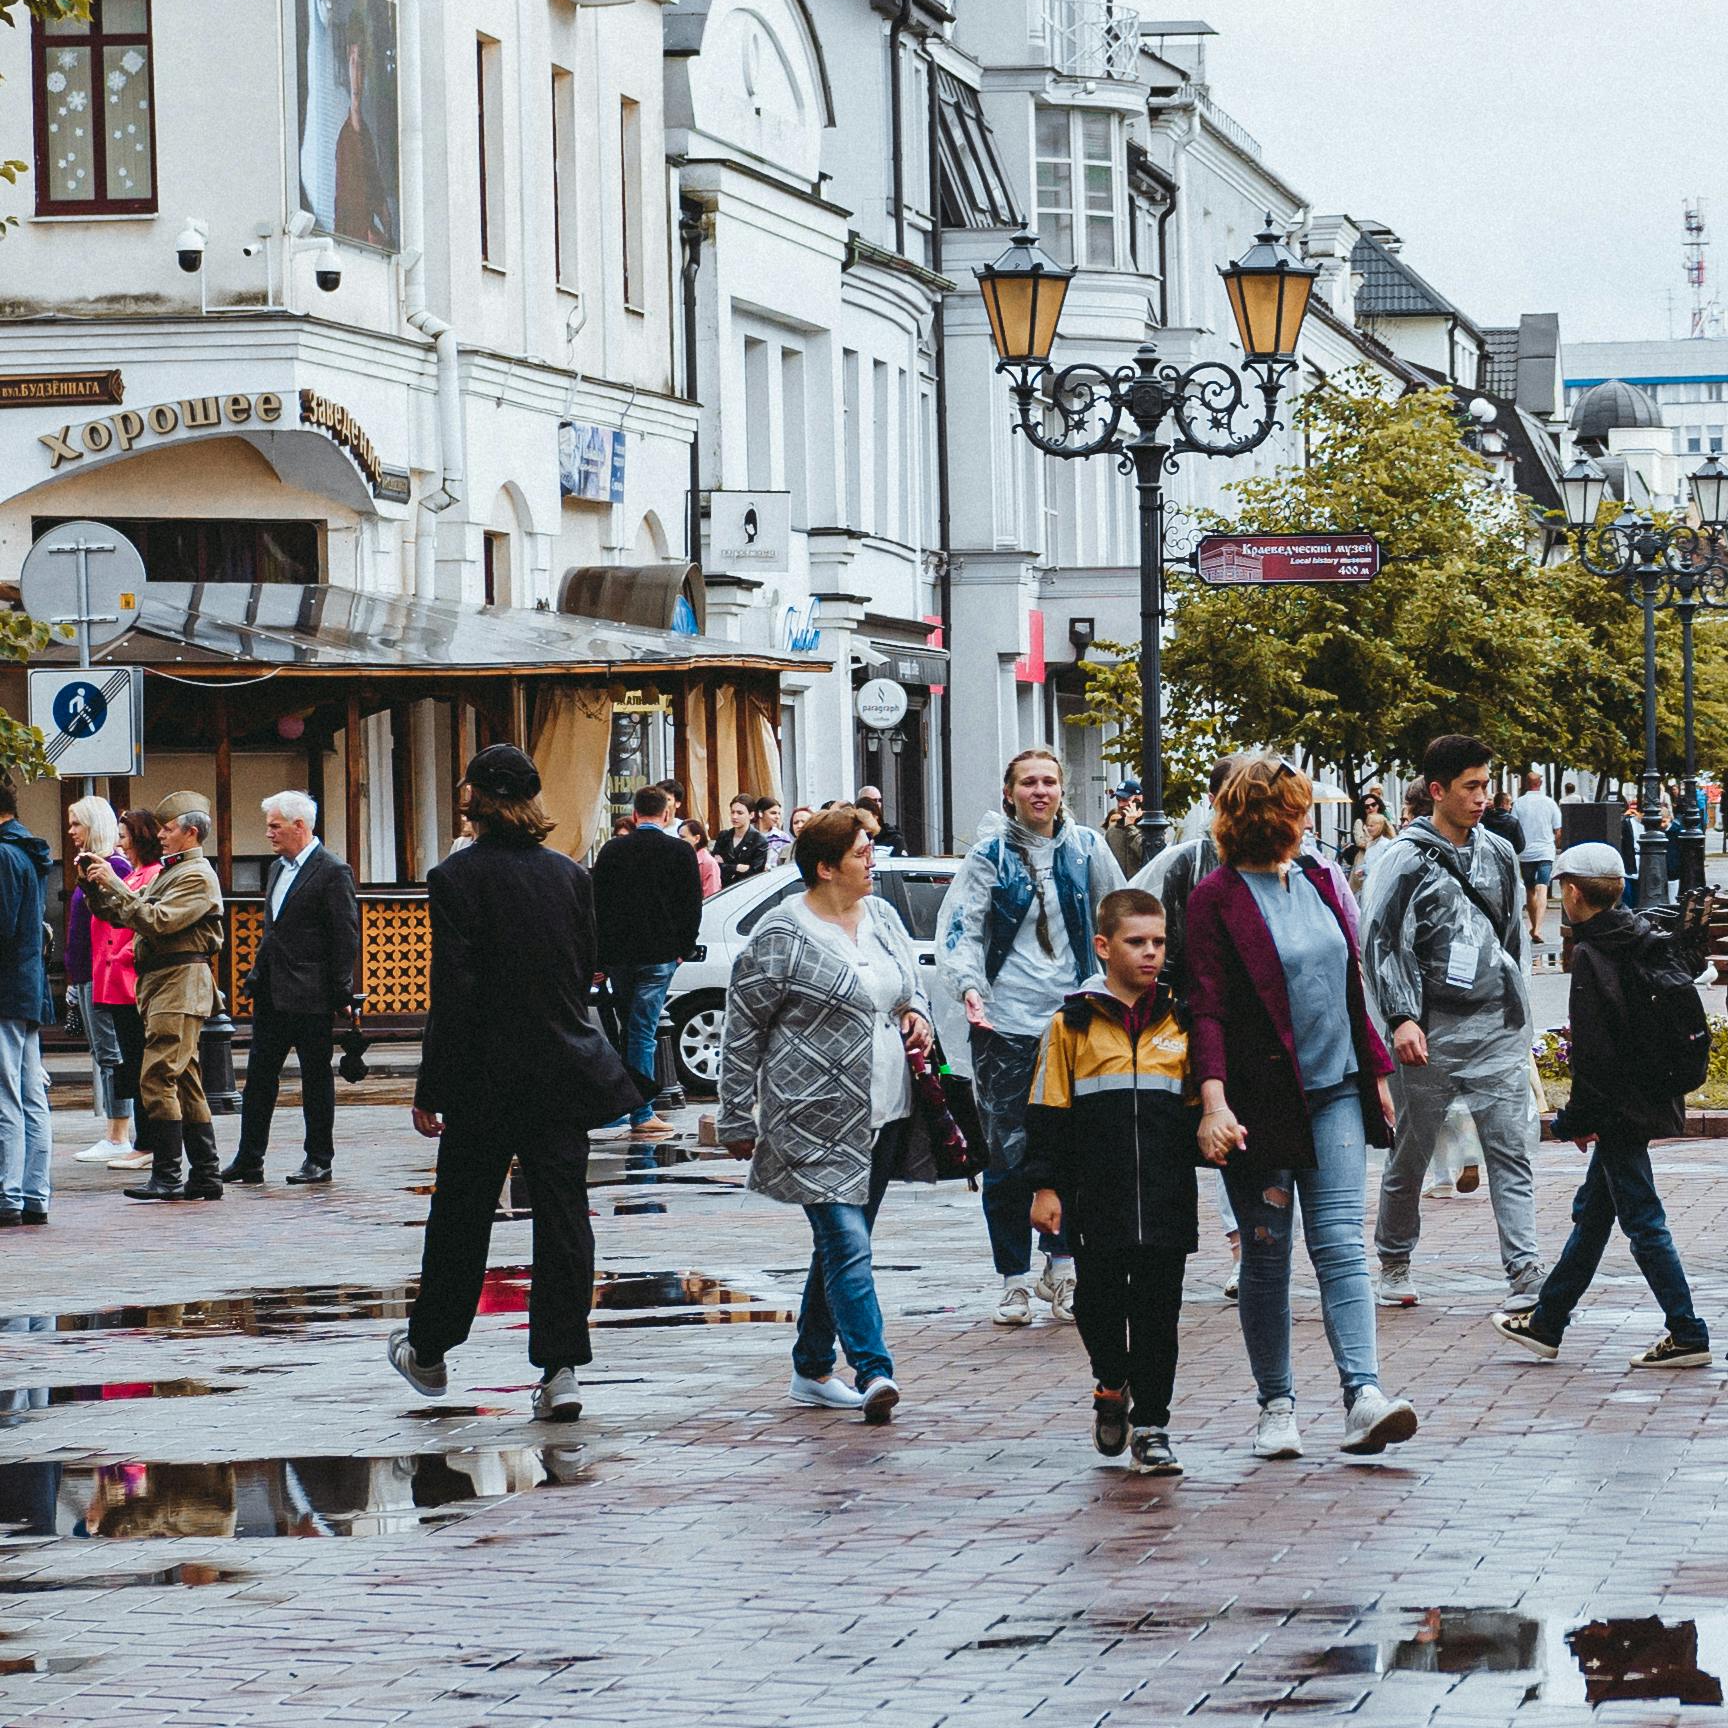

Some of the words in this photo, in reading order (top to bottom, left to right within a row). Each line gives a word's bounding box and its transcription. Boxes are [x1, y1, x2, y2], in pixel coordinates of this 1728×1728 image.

[1242, 542, 1331, 557] Краеведческий
[1335, 542, 1372, 556] музей
[1290, 557, 1312, 565] Local
[1312, 556, 1339, 566] history
[1338, 565, 1360, 575] 400
[862, 703, 900, 713] paragraph
